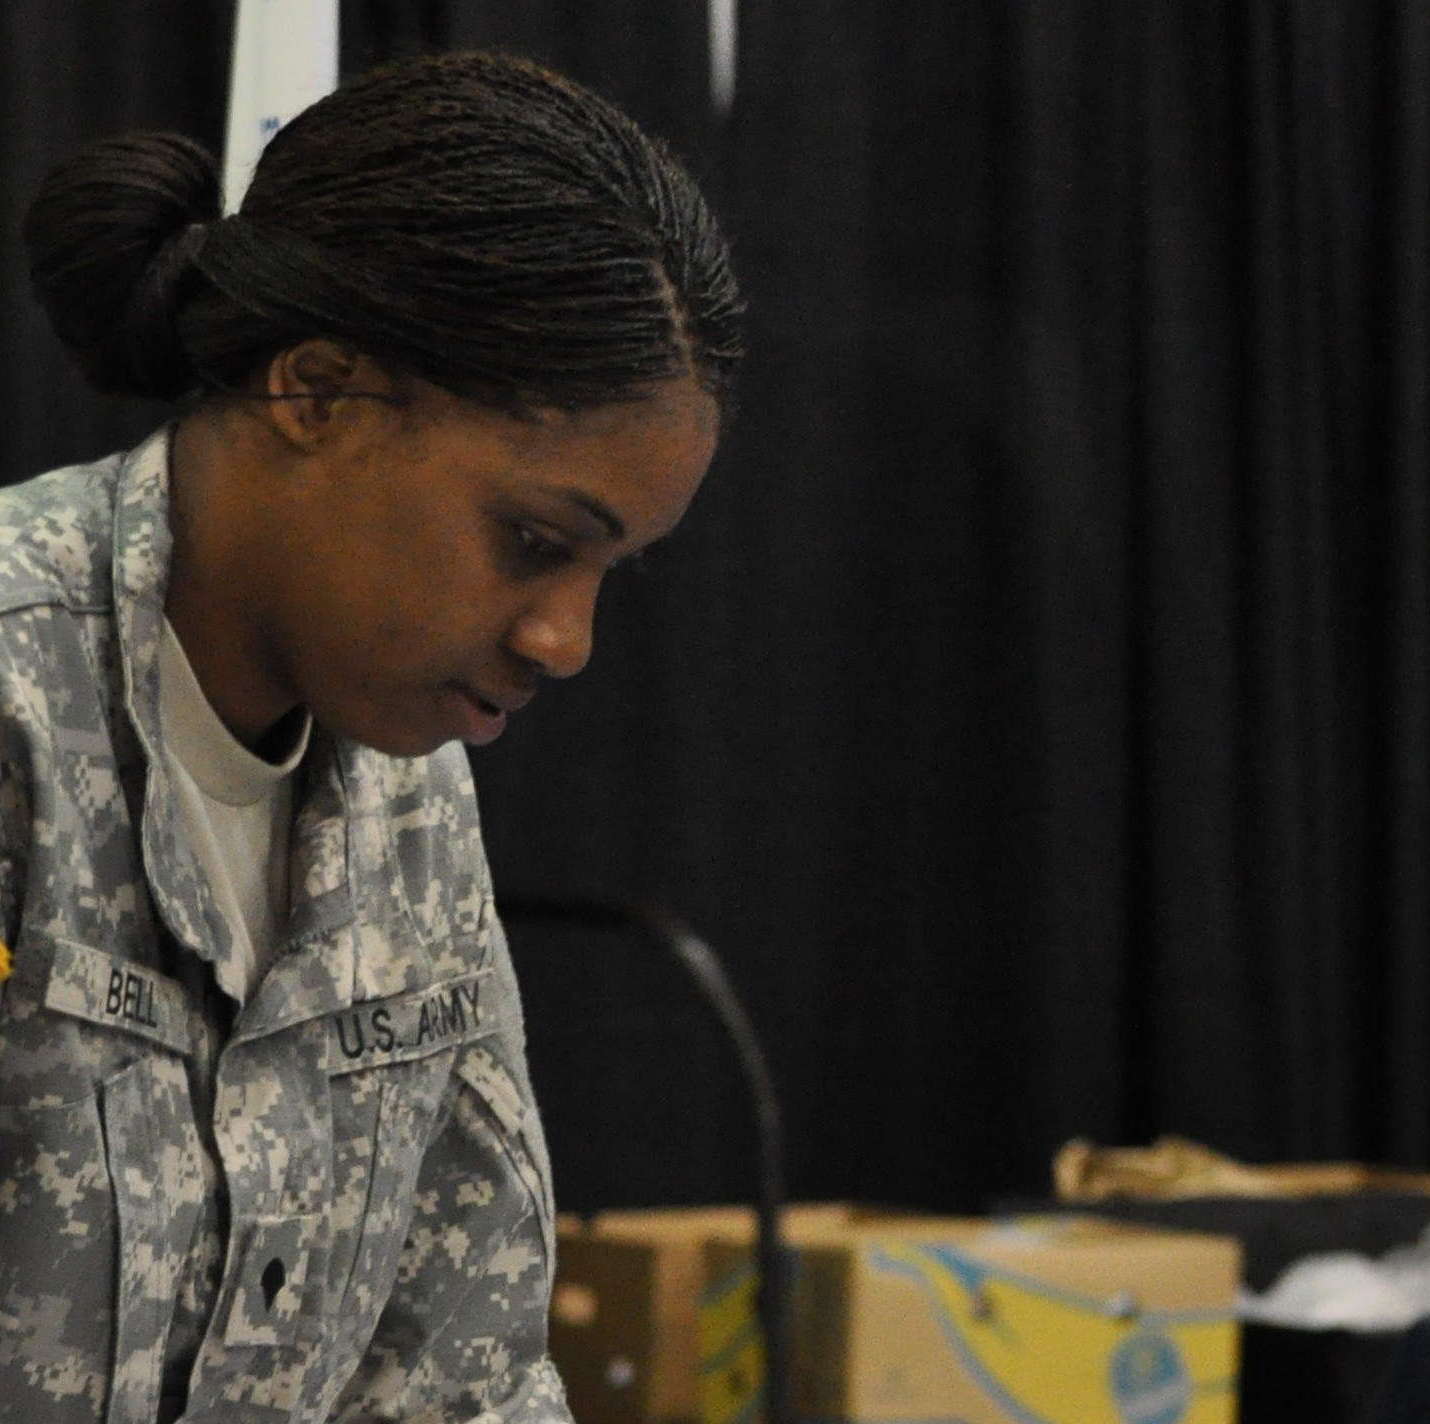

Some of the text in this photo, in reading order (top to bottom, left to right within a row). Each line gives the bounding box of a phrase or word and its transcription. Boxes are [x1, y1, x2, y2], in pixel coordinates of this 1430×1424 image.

[106, 967, 159, 1028] BELL
[334, 984, 481, 1058] U.S. ARMY
